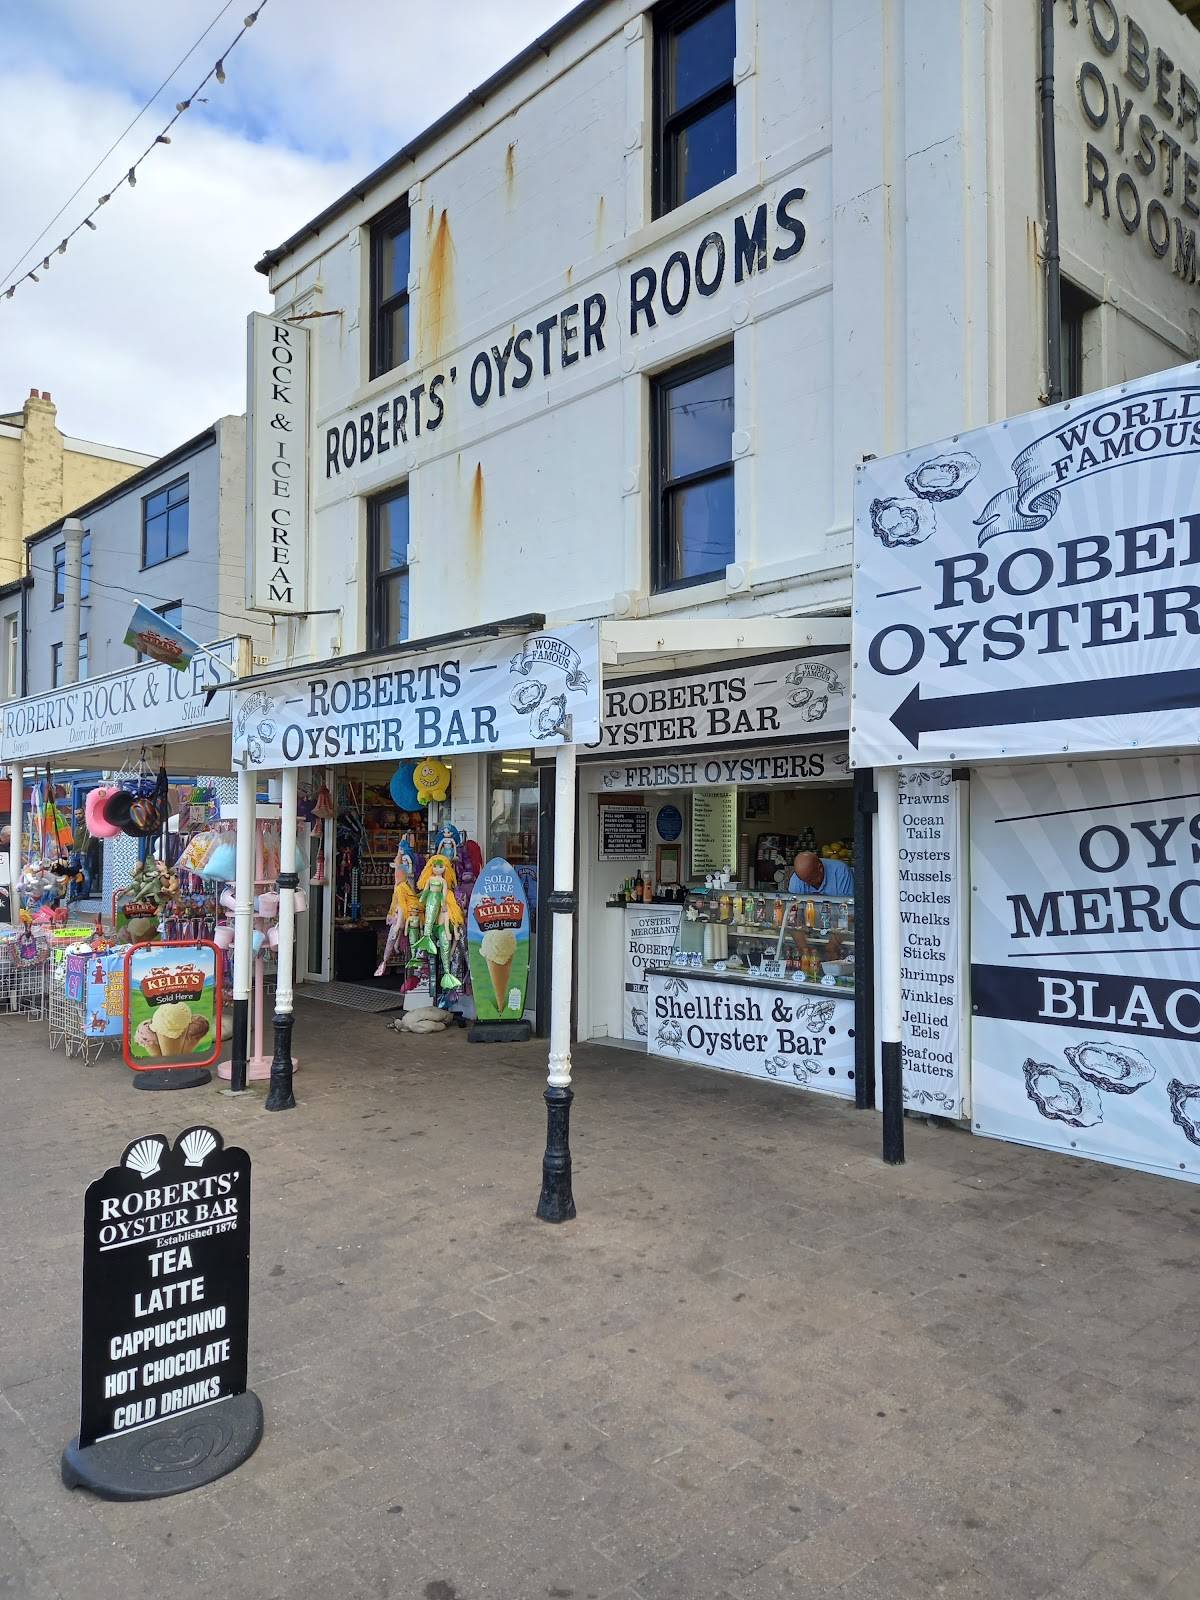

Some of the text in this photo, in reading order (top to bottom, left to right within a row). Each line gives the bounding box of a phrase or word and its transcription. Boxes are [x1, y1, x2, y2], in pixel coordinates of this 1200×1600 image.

[1084, 142, 1200, 285] ROOM
[326, 187, 806, 479] ROBERTS' OYSTER ROOMS
[267, 325, 294, 603] ROCK & ICE CREAM
[934, 513, 1200, 611] ROBE
[535, 639, 571, 658] WORLD
[532, 650, 570, 669] FAMOUS
[802, 670, 831, 682] FAMOUS
[804, 664, 831, 675] WORLD
[6, 654, 221, 739] ROBERTS' ROCK & ICES
[307, 659, 462, 718] ROBERTS
[605, 677, 747, 718] ROBERTS
[69, 721, 124, 744] Dairy Ice Cream
[282, 705, 499, 762] OYSTER BAR
[584, 705, 781, 749] YSTER BAR
[624, 753, 825, 788] FRESH OYSTERS
[898, 793, 950, 805] Prawns
[903, 814, 944, 825] Ocean
[907, 828, 941, 839] Tails
[899, 848, 950, 863] Oysters
[484, 874, 513, 886] SOLD
[899, 870, 952, 882] Mussels
[483, 884, 514, 894] HERE
[899, 890, 951, 904] Cockles
[478, 903, 520, 918] KELLY'S
[900, 911, 950, 925] Whelks
[484, 919, 517, 931] Sold Here
[639, 917, 671, 927] OYSTER
[908, 933, 941, 947] Crab
[903, 946, 946, 961] Sticks
[147, 974, 200, 991] KELLY'S
[156, 992, 194, 1004] Sold Here
[655, 995, 793, 1023] Shellfish &
[902, 1010, 949, 1027] Jellied
[686, 1023, 827, 1056] Oyster Bar
[911, 1025, 940, 1040] Eels
[100, 1171, 240, 1222] ROBERTS'
[99, 1197, 239, 1244] OYSTER BAR
[156, 1220, 237, 1248] Established 1876
[148, 1246, 193, 1278] TEA
[134, 1276, 205, 1318] LATTE
[110, 1305, 226, 1361] CAPPUCCINNO
[104, 1338, 231, 1399] HOT CHOCOLATE
[113, 1376, 221, 1430] COLD DRINKS
